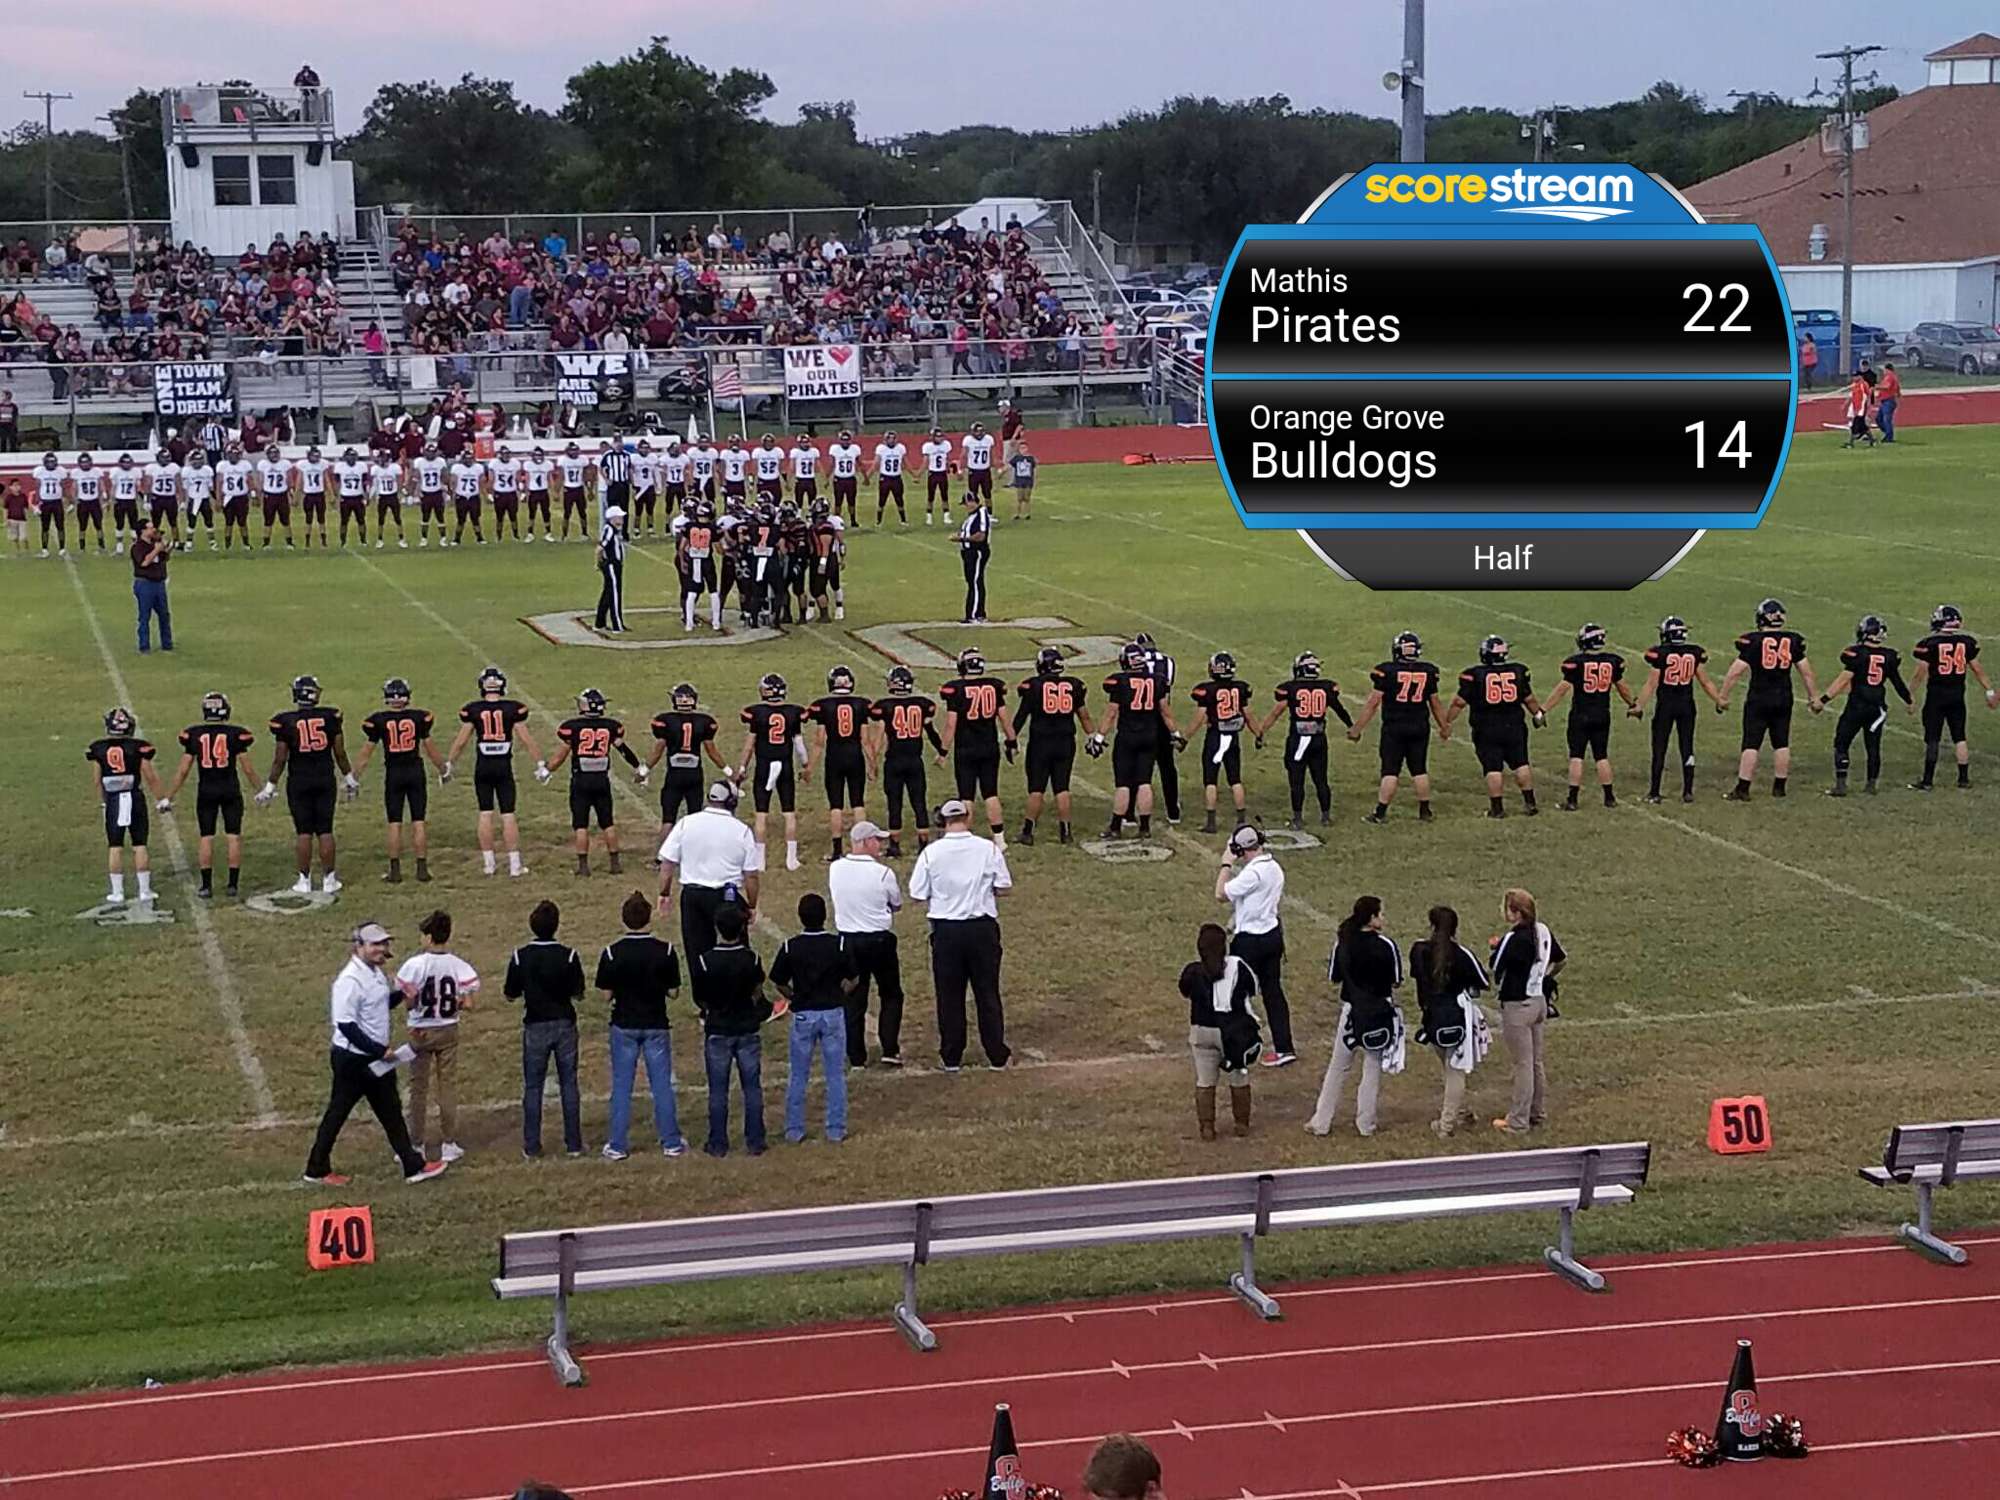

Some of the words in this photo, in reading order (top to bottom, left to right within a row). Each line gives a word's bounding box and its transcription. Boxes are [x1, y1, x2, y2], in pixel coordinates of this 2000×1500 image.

[173, 364, 226, 379] TOWN
[557, 355, 628, 375] WE
[787, 349, 824, 368] WE
[155, 364, 175, 415] ONE
[174, 381, 222, 396] TEAM
[558, 378, 592, 391] ARE
[787, 381, 858, 397] PIRATES
[807, 369, 837, 381] OUR
[176, 398, 233, 415] DREAM
[732, 463, 739, 475] 3
[973, 450, 988, 464] 70
[154, 478, 172, 492] 35
[195, 480, 202, 492] 7
[226, 476, 244, 490] 64
[267, 474, 283, 487] 72
[343, 477, 359, 489] 57
[424, 472, 438, 487] 23
[461, 477, 476, 492] 75
[758, 526, 770, 549] 7
[1761, 637, 1791, 669] 64
[1938, 643, 1966, 675] 54
[1663, 653, 1695, 686] 20
[1867, 654, 1885, 687] 5
[965, 684, 997, 719] 70
[1042, 681, 1074, 714] 66
[1129, 677, 1154, 711] 71
[1396, 671, 1427, 703] 77
[1485, 672, 1517, 704] 65
[1216, 687, 1239, 719] 21
[1296, 689, 1326, 718] 30
[296, 717, 328, 753] 15
[480, 710, 506, 741] 11
[768, 713, 786, 744] 2
[837, 703, 854, 738] 8
[892, 704, 923, 739] 40
[386, 718, 416, 753] 12
[577, 727, 610, 756] 23
[682, 722, 693, 751] 1
[106, 745, 127, 773] 9
[199, 732, 229, 769] 14
[421, 976, 457, 1019] 48
[1722, 1104, 1765, 1145] 50
[319, 1216, 367, 1262] 40
